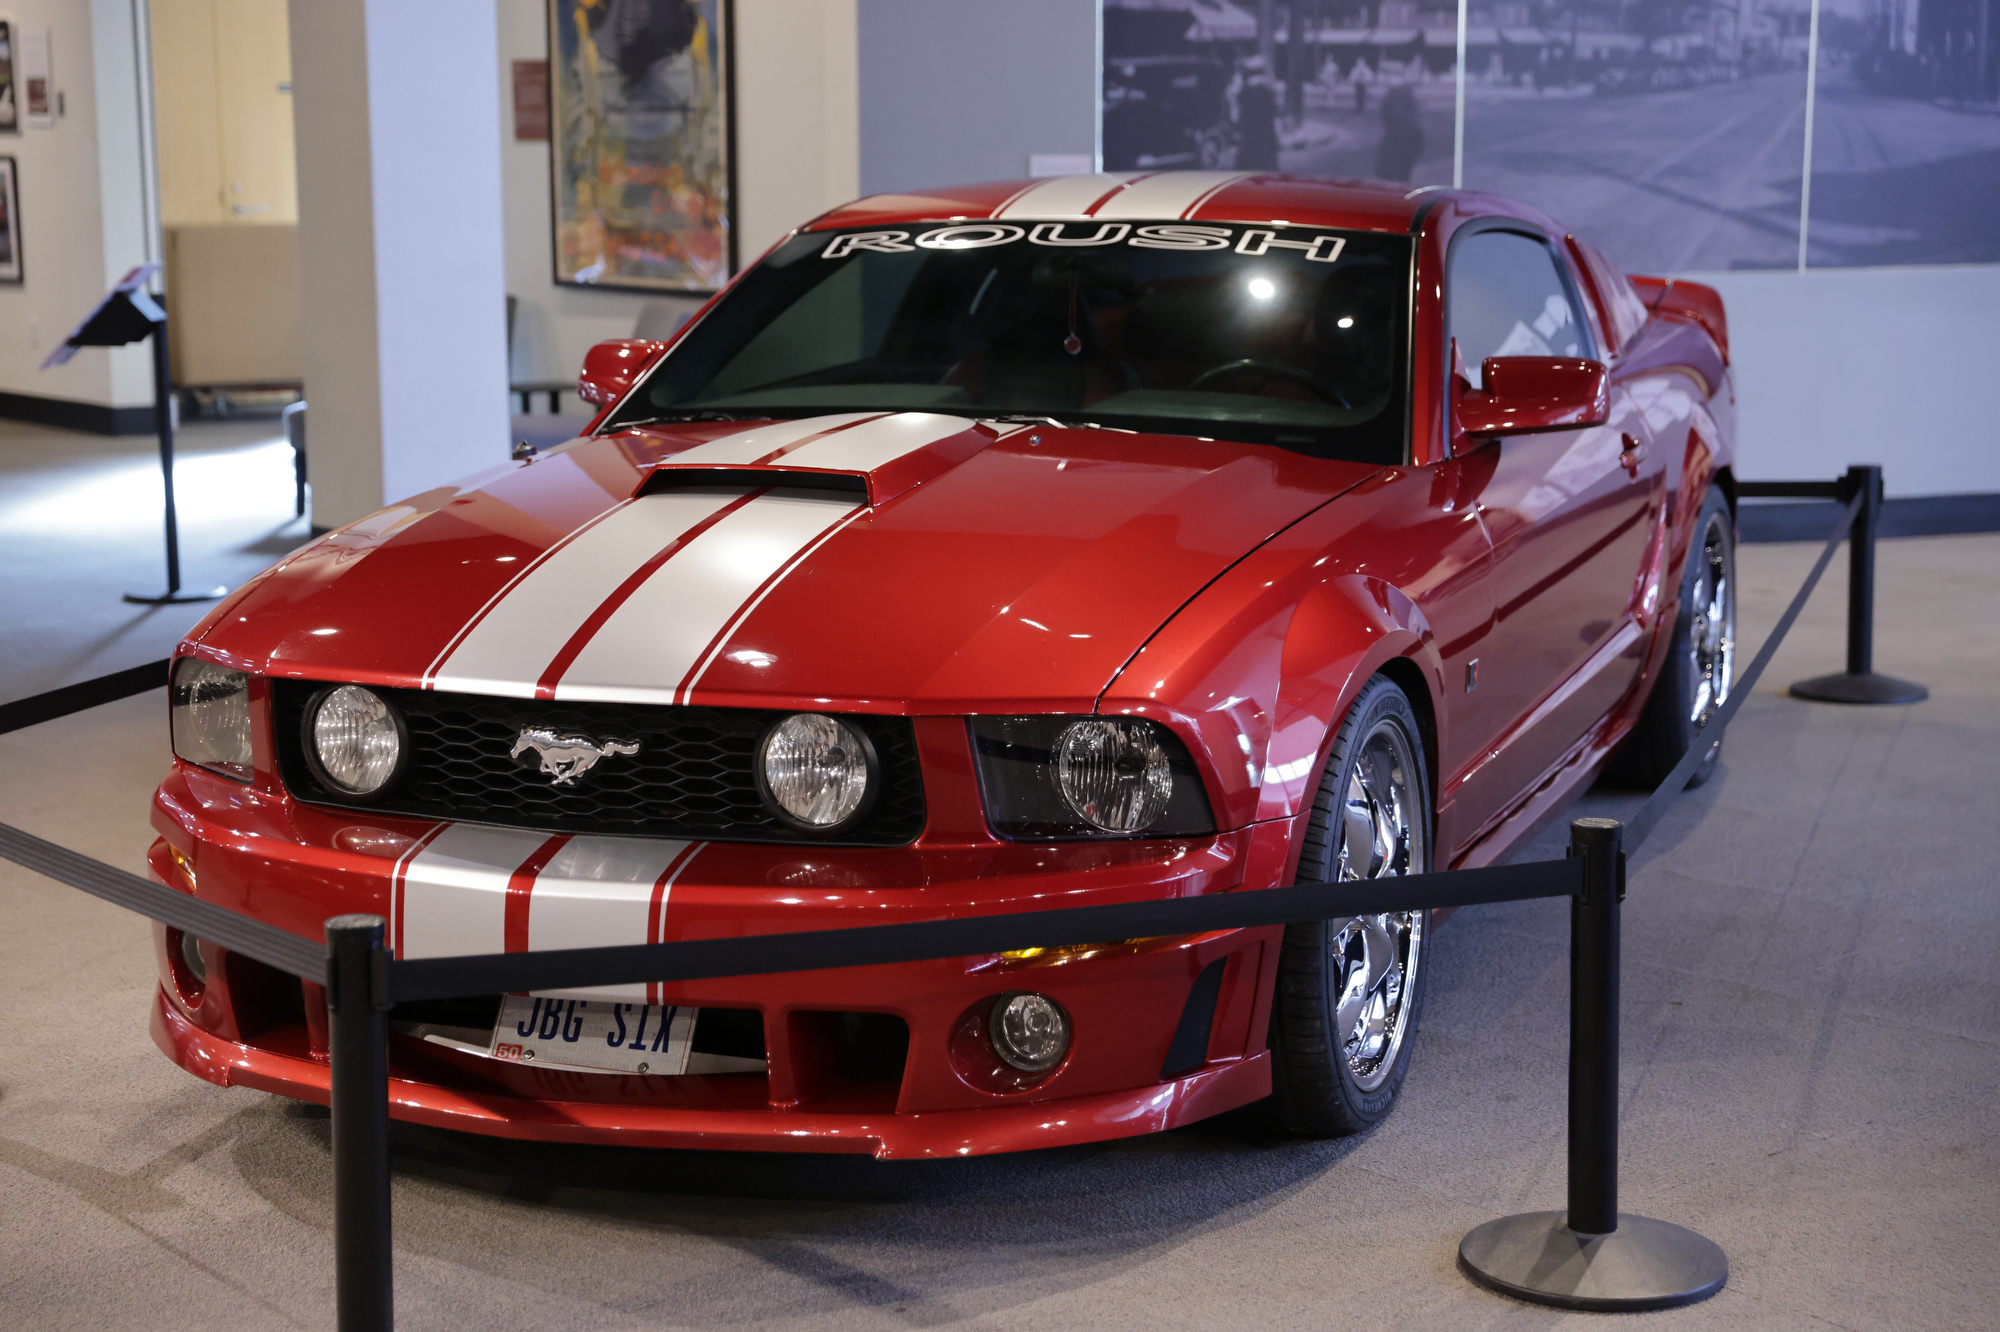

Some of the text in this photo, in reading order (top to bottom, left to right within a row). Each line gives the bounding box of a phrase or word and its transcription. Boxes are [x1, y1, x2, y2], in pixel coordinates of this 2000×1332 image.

[821, 223, 1346, 263] ROUSH
[517, 997, 678, 1053] JBG SIX
[497, 1046, 519, 1059] 50
